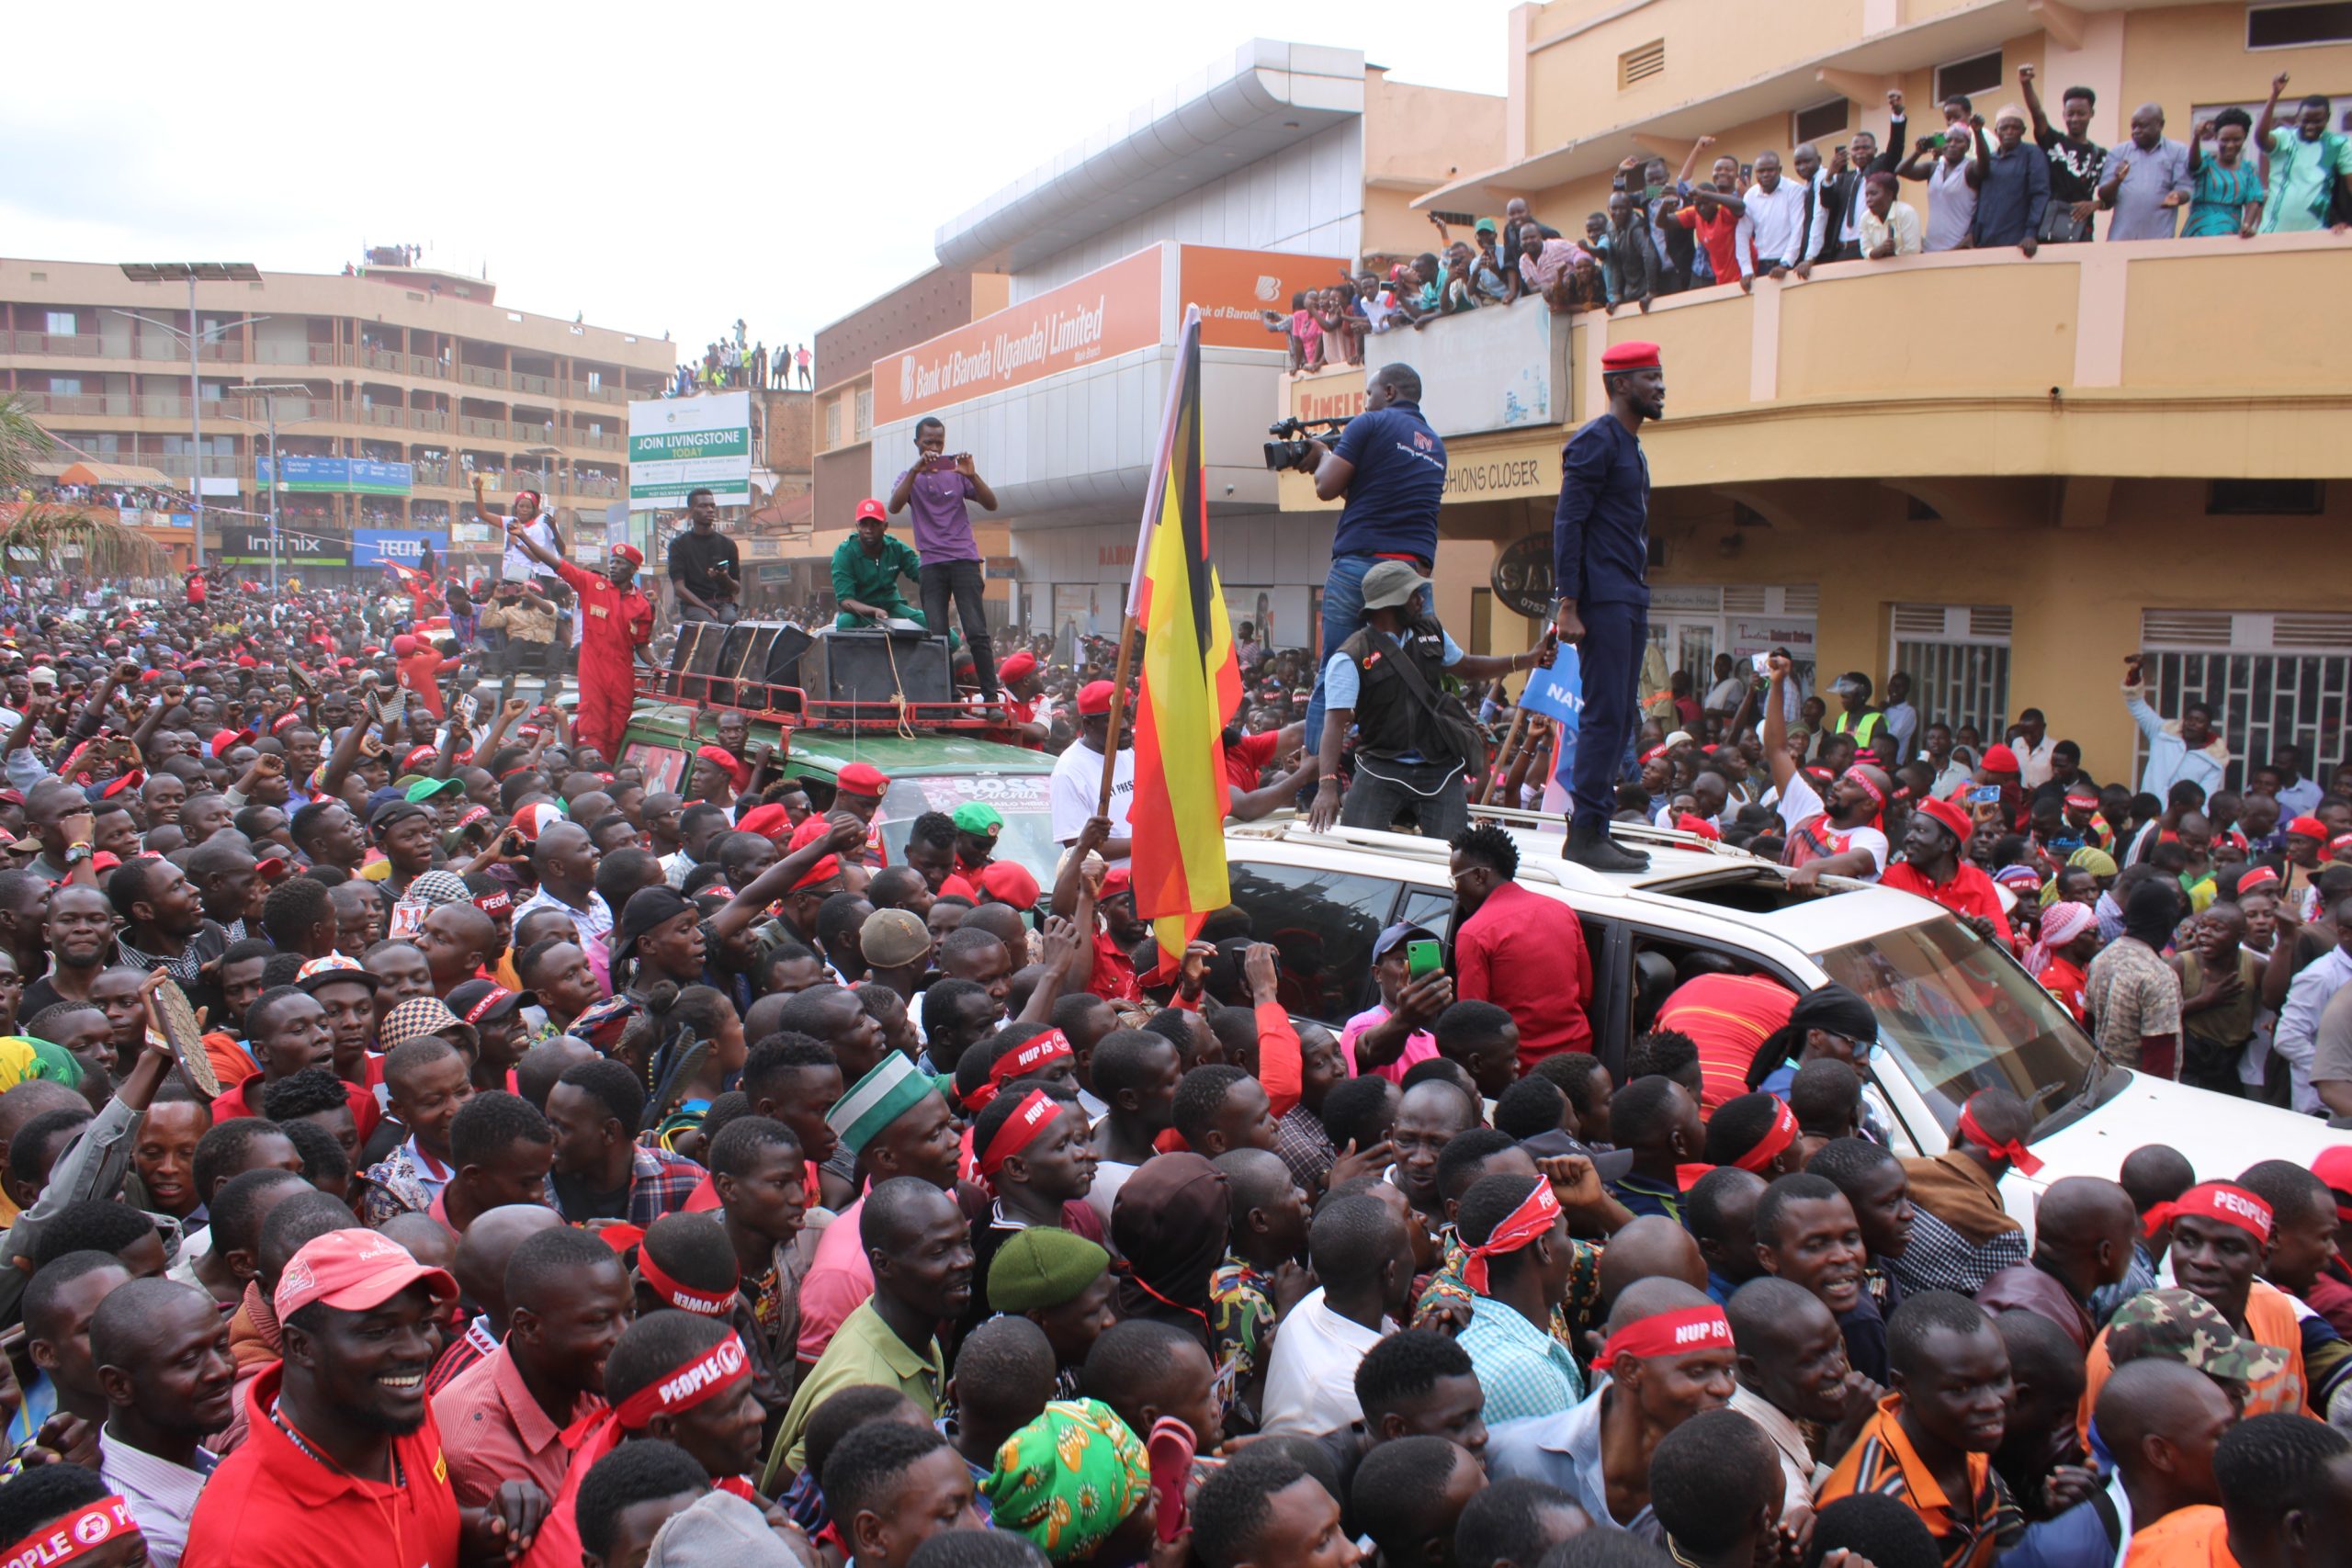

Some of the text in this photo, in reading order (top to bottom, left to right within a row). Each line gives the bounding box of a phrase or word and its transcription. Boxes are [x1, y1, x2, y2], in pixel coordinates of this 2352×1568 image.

[1215, 306, 1225, 318] of
[916, 294, 1104, 399] Bank of Baroda (Uganda) Limited
[1300, 391, 1363, 423] TIMELE
[638, 431, 740, 450] JOIN LIVINGSTONE
[672, 447, 703, 458] TODAY
[1442, 459, 1540, 493] SHIONS CLOSER
[1547, 682, 1586, 714] NAT
[954, 778, 1047, 793] BOSS
[973, 785, 1038, 800] Events
[1116, 780, 1134, 794] PRES
[460, 805, 490, 827] EOPLE
[1018, 1041, 1054, 1066] NUP IS
[1024, 1100, 1046, 1125] NUP
[2213, 1190, 2271, 1232] PEOPLE
[673, 1291, 720, 1314] POWER
[1675, 1320, 1726, 1344] NUP IS
[659, 1357, 721, 1405] PEOPLE
[2, 1530, 74, 1568] OPLE
